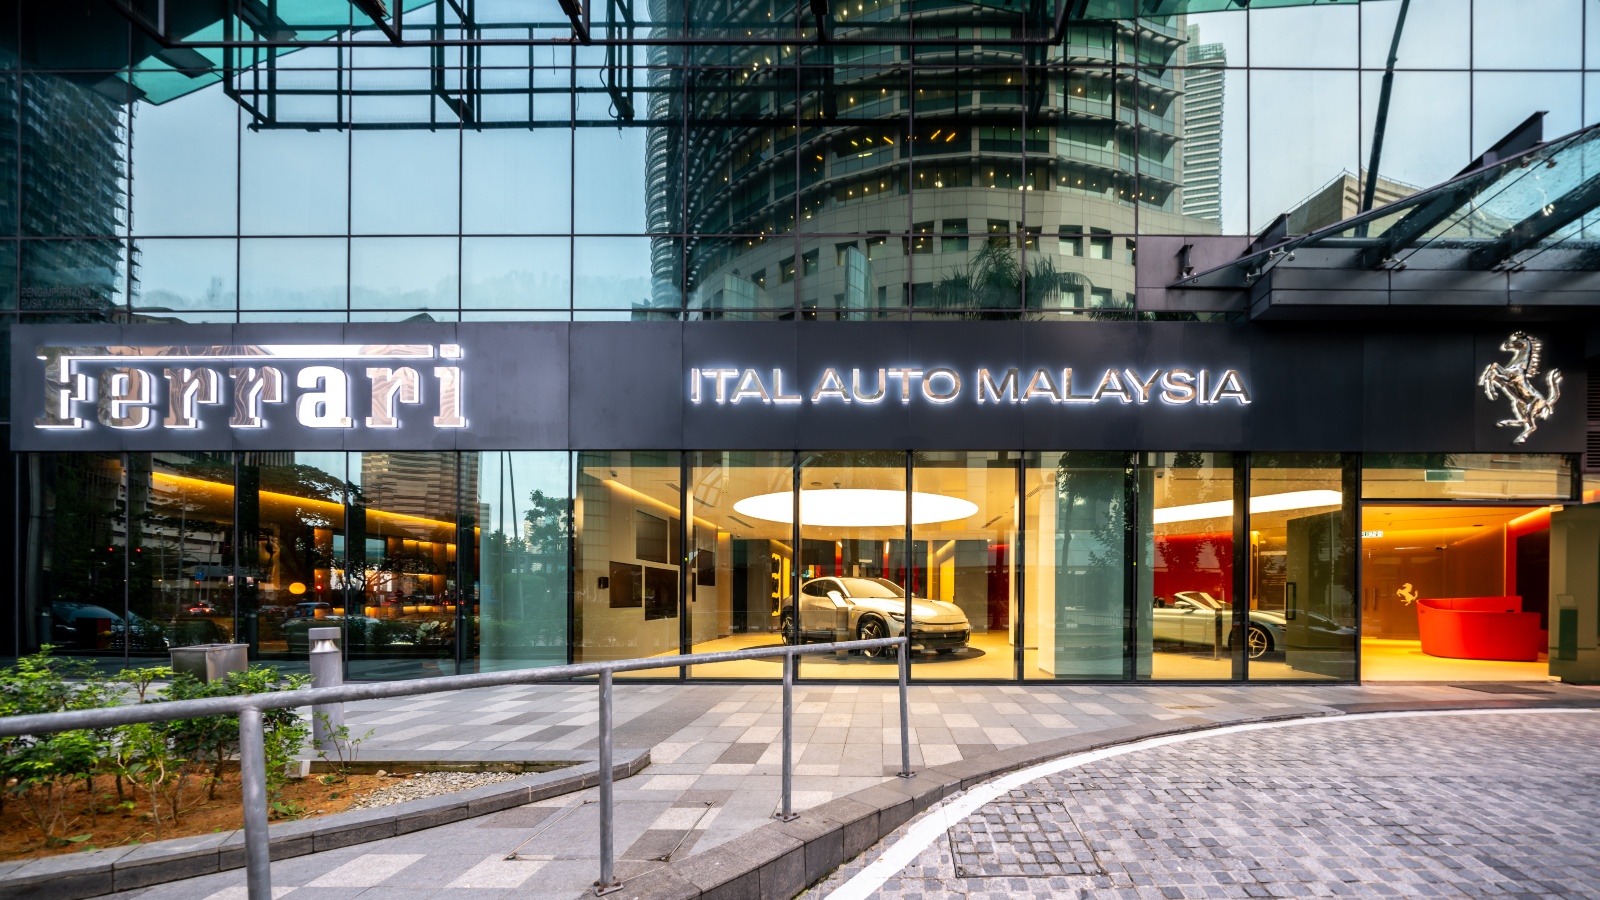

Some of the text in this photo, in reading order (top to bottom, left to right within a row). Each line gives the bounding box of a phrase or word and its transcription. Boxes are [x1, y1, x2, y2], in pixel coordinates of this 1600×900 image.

[21, 299, 47, 309] PUSAT
[34, 344, 467, 429] Ferrari
[690, 367, 1252, 404] ITAL AUTO MALAYSIA
